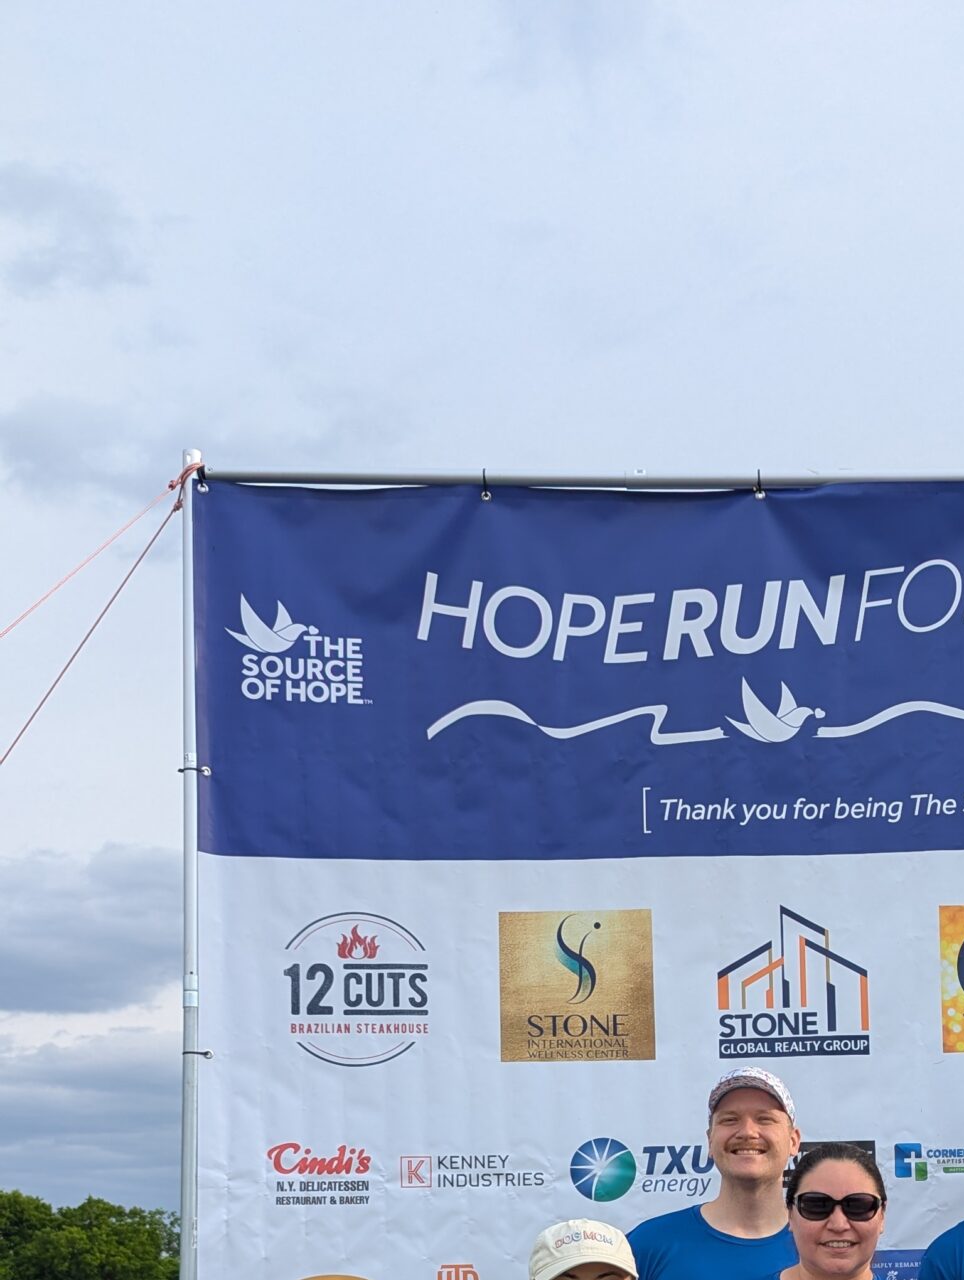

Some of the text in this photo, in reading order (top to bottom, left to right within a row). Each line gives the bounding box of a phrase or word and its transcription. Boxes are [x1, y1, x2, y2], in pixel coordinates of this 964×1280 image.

[416, 571, 656, 664] HOPE
[662, 574, 846, 661] RUN
[303, 633, 363, 659] THE
[241, 655, 364, 682] SOURCE
[241, 678, 365, 705] OF HOPE
[660, 798, 737, 822] Thank
[740, 802, 788, 828] you
[793, 796, 831, 826] for
[834, 794, 903, 824] being
[910, 794, 957, 817] The
[283, 962, 429, 1016] 12 CUTS
[290, 1023, 429, 1034] BRAZILIAN STEAKHOUSE
[527, 1014, 630, 1038] STONE
[718, 1011, 819, 1039] STONE
[527, 1038, 628, 1049] INTERNATIONAL
[528, 1049, 629, 1060] WELLNESS CENTER
[721, 1039, 868, 1055] GLOBAL REALTY GROUP
[267, 1142, 372, 1176] Cindi's
[437, 1154, 510, 1170] KENNEY
[642, 1145, 714, 1175] TXU
[276, 1180, 370, 1192] N.Y. DELICATESSEN
[437, 1172, 545, 1188] INDUSTRIES
[642, 1176, 712, 1197] energy
[275, 1195, 370, 1206] RESTAURANT & BAKERY
